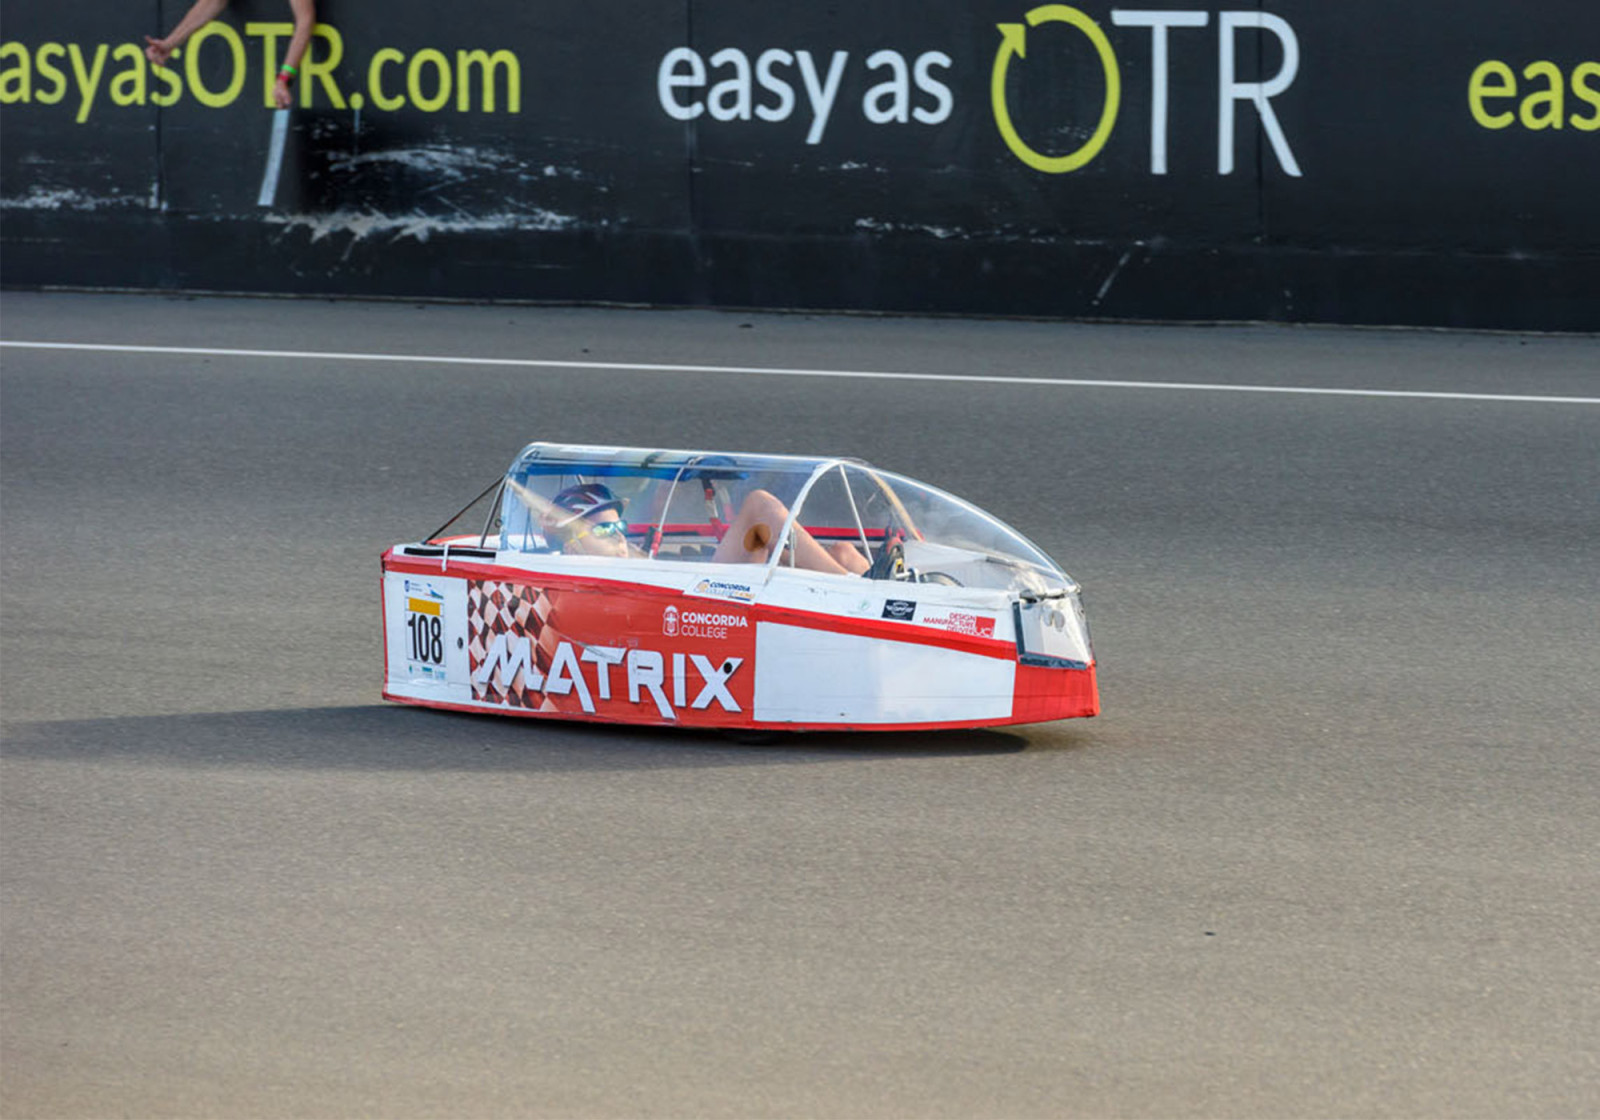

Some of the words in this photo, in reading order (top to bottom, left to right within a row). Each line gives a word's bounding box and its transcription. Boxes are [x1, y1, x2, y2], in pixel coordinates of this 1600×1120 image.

[658, 47, 848, 144] easy
[863, 50, 953, 125] as
[992, 4, 1302, 177] OTR
[1468, 60, 1600, 131] eas
[710, 581, 750, 592] CONCORDIA
[681, 612, 748, 627] CONCORDIA
[923, 617, 975, 628] MANUFACTURE
[949, 612, 976, 622] DESIGN
[407, 613, 443, 664] 108
[681, 625, 728, 639] COLLEGE
[477, 633, 744, 720] MATRIX
